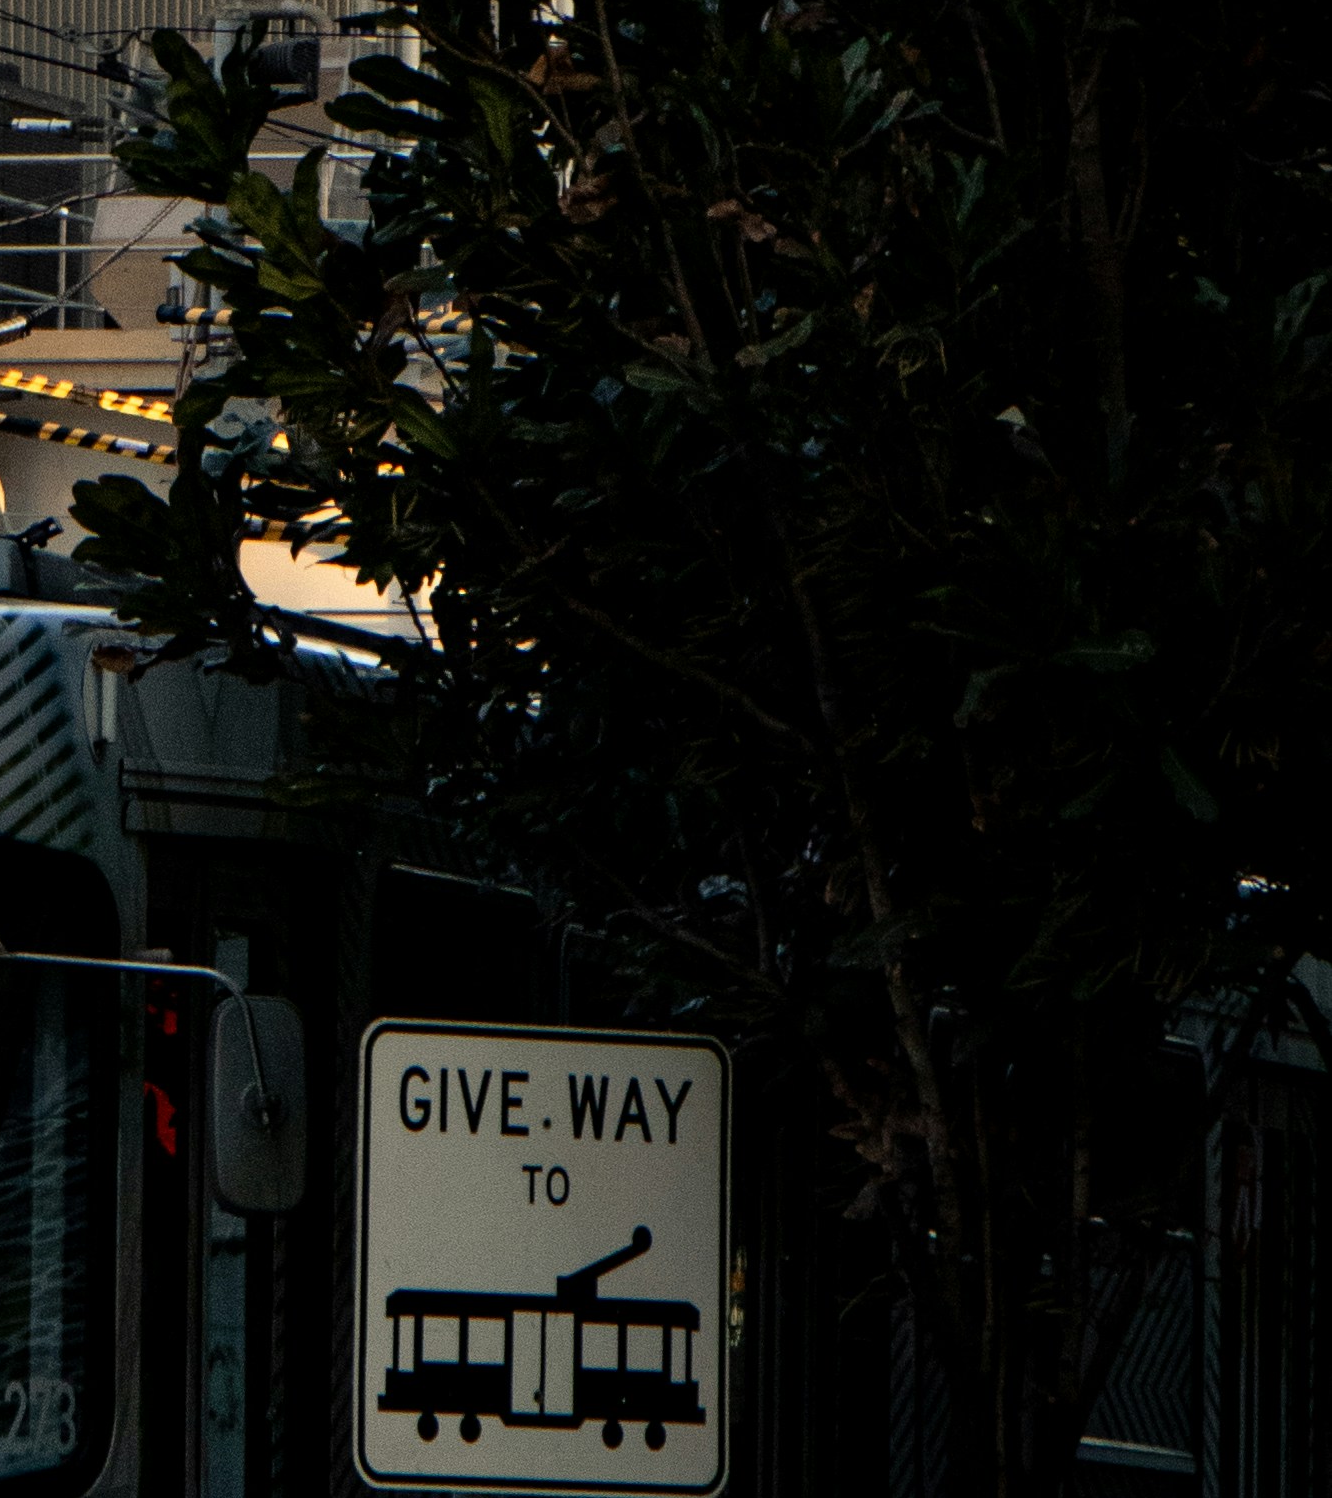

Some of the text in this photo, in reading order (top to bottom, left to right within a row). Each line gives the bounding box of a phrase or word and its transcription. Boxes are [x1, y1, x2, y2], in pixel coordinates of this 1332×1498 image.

[400, 1066, 692, 1144] GIVE WAY
[522, 1165, 569, 1205] TO
